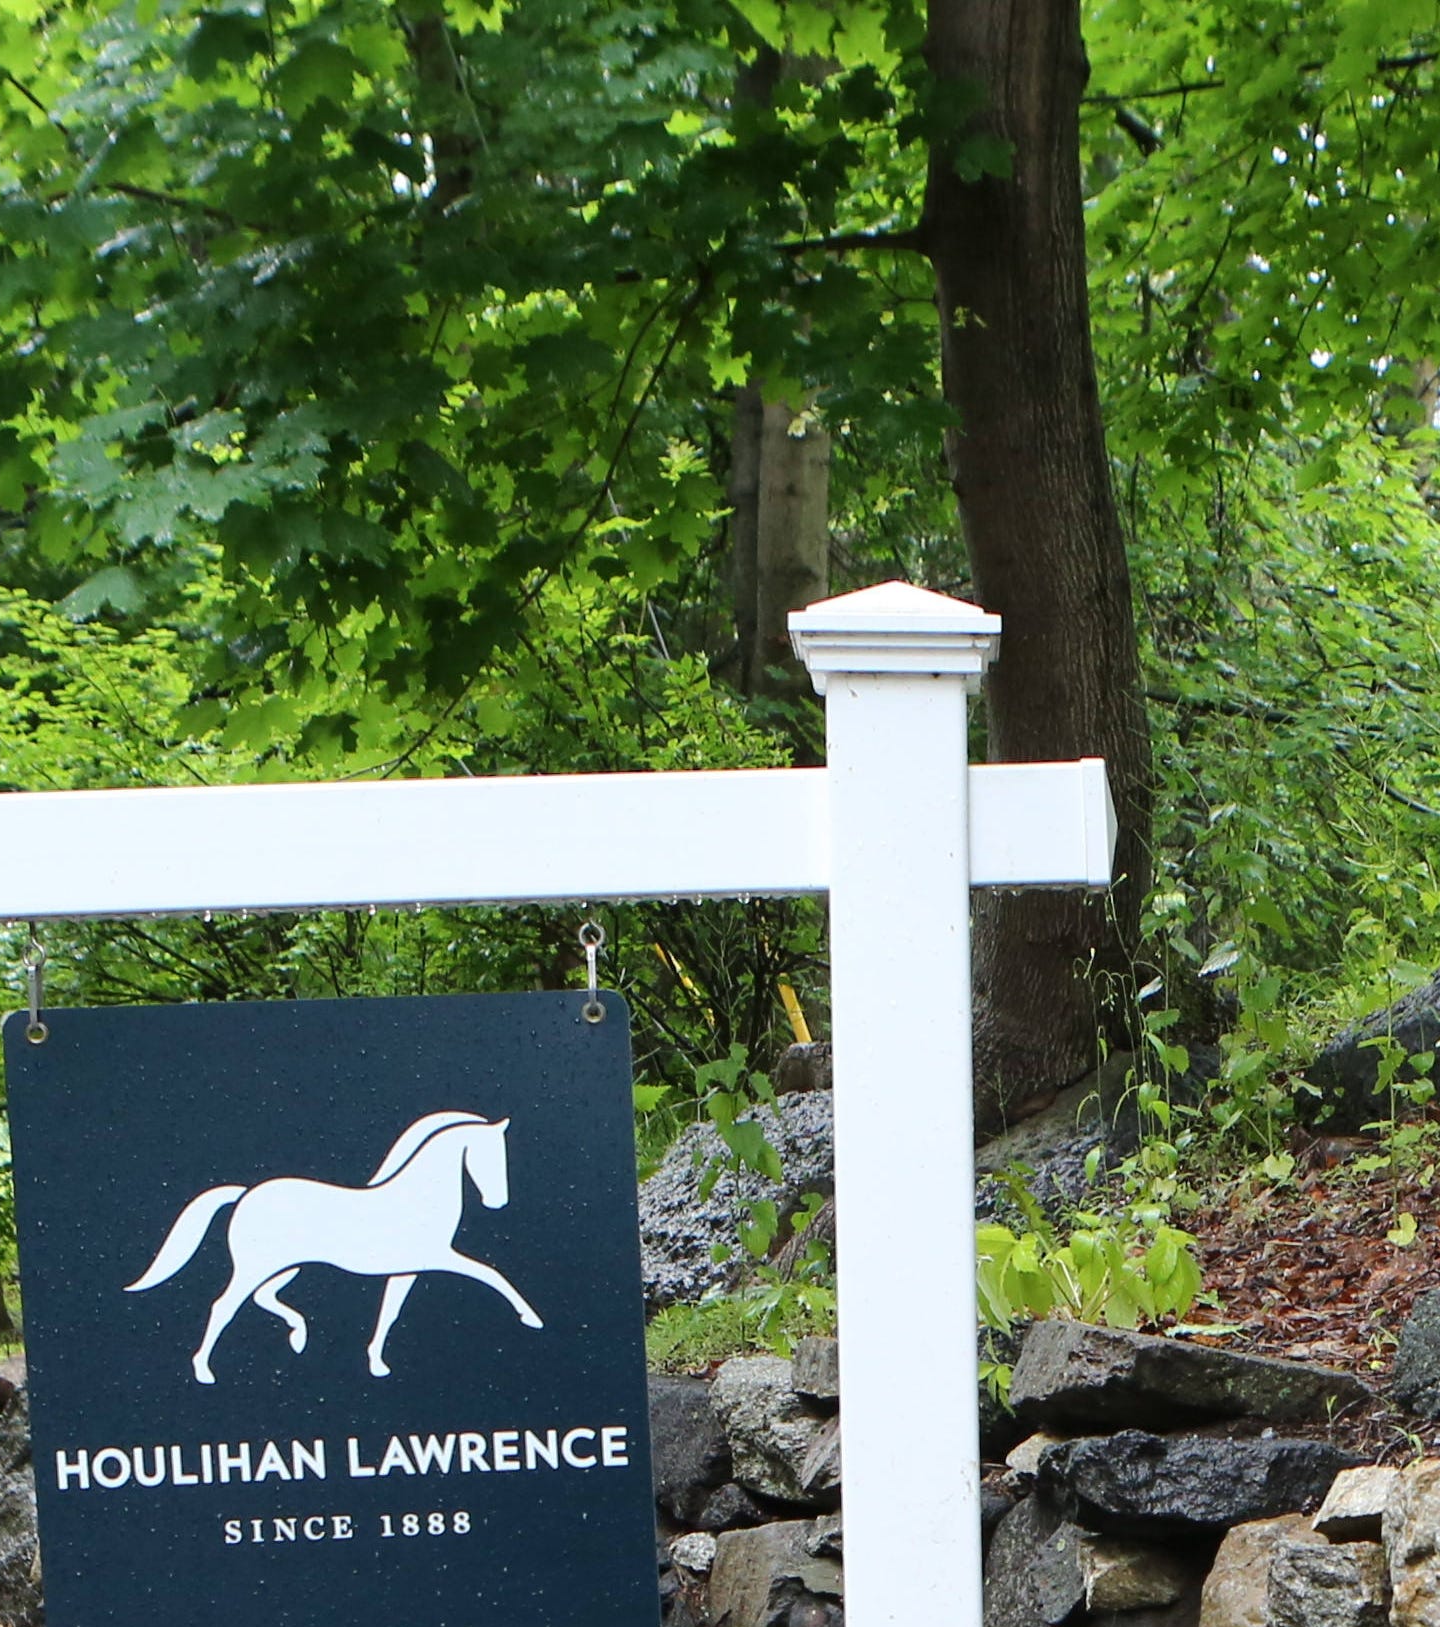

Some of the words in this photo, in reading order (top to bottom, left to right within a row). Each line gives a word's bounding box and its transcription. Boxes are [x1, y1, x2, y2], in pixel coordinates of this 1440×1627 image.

[56, 1439, 326, 1490] HOULIHAN
[347, 1426, 629, 1478] LAWRENCE
[224, 1515, 353, 1544] SINCE
[380, 1511, 471, 1537] 1888
